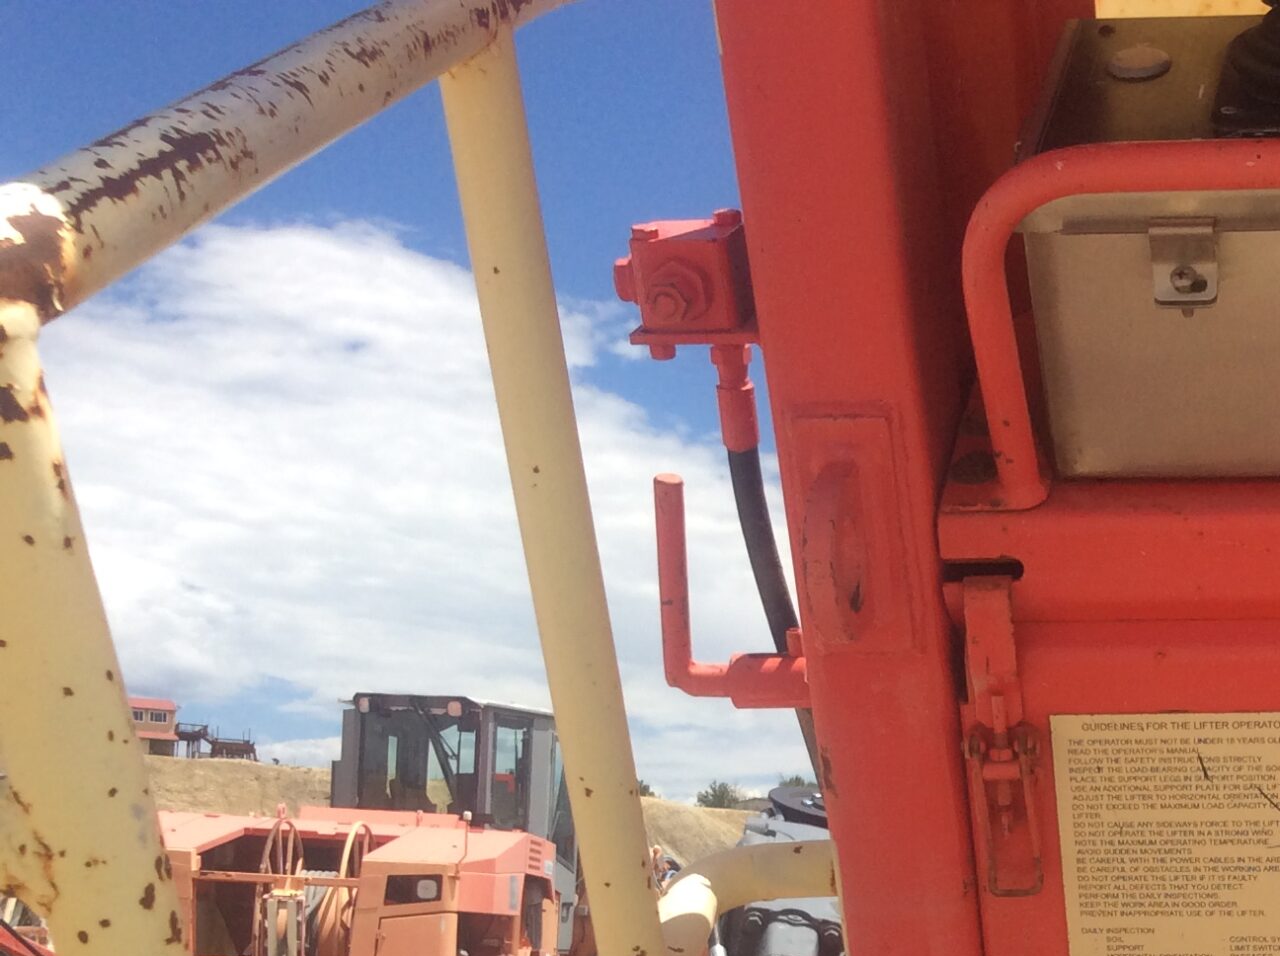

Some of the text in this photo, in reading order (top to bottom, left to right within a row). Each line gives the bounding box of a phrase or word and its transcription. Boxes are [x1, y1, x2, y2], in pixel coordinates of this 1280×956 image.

[1082, 722, 1142, 731] GUIDELINES
[1146, 722, 1168, 730] FOR
[1171, 721, 1190, 730] THE
[1193, 721, 1229, 730] LIFTER
